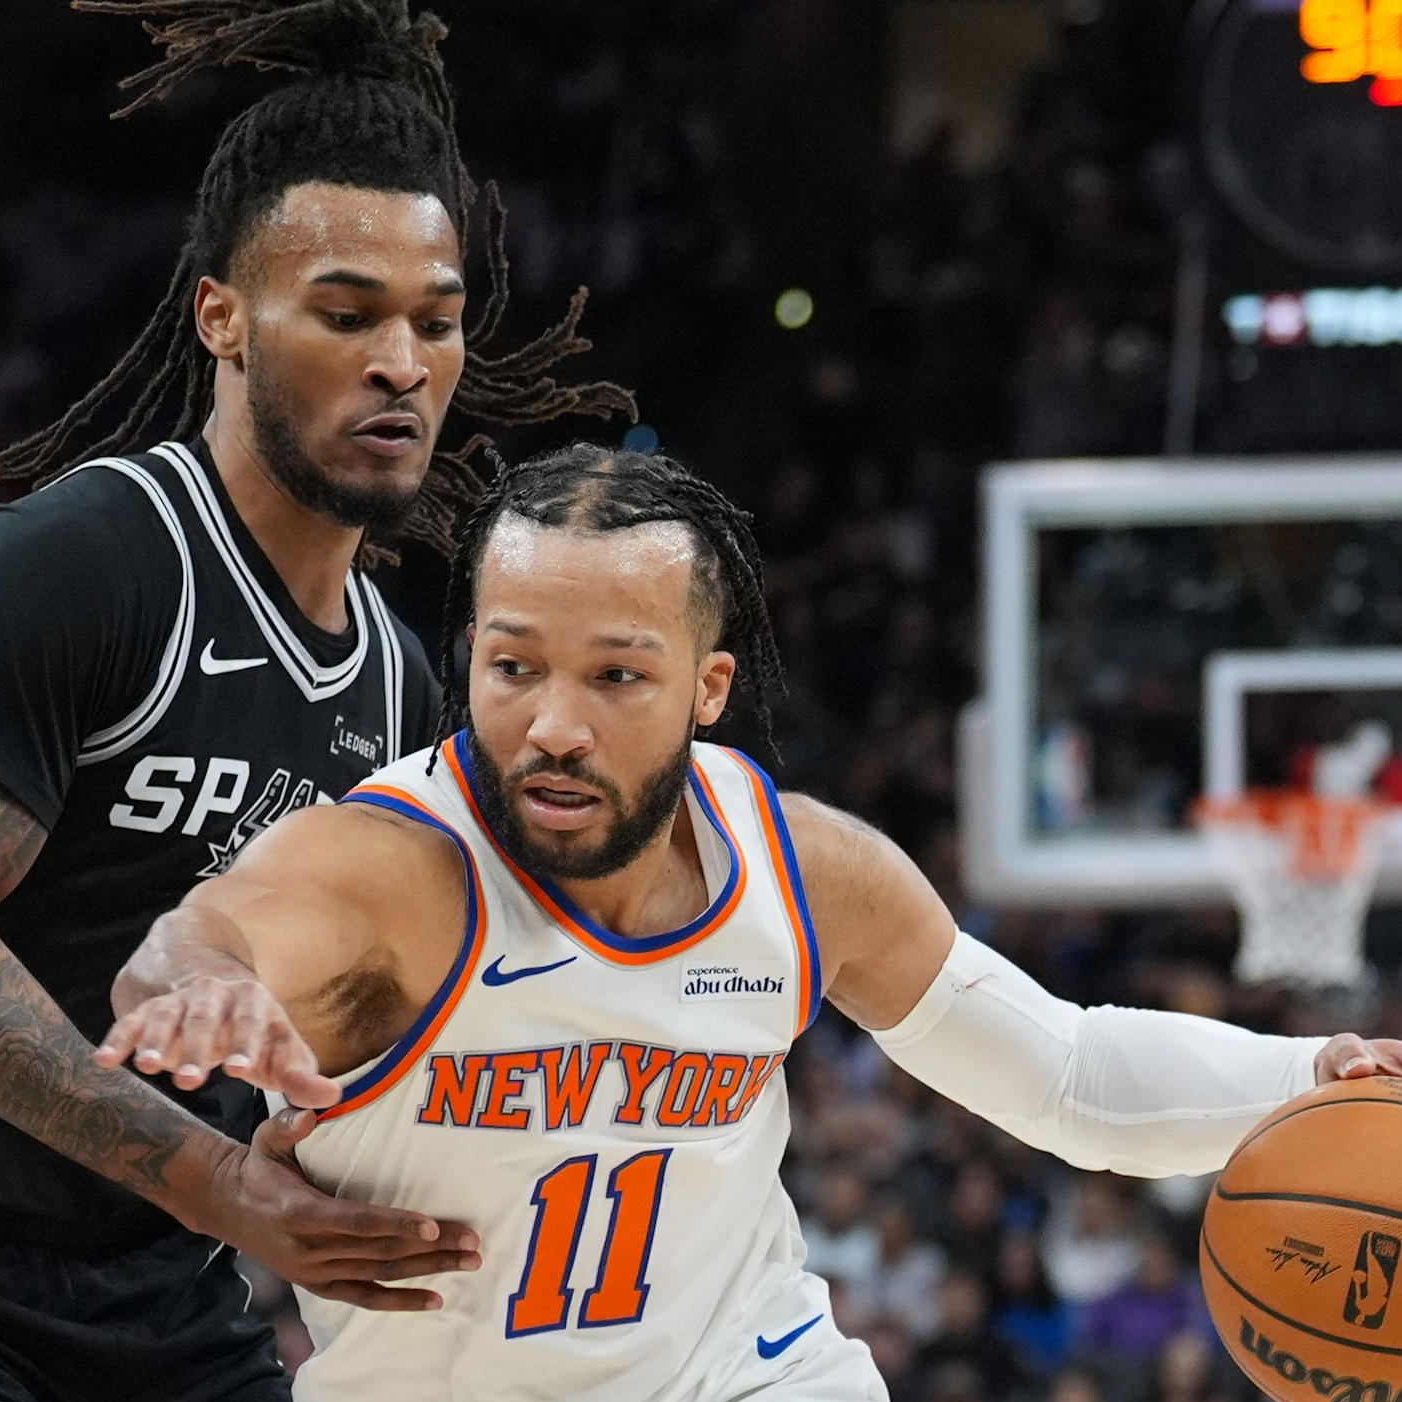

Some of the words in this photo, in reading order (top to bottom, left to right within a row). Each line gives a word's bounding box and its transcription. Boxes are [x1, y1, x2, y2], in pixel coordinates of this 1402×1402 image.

[338, 728, 378, 762] LEDGER
[684, 977, 721, 996] abu
[723, 975, 785, 995] dhabi
[686, 966, 740, 977] experience
[415, 1040, 613, 1134] NEW
[610, 1038, 787, 1130] YORK
[505, 1148, 673, 1339] 11
